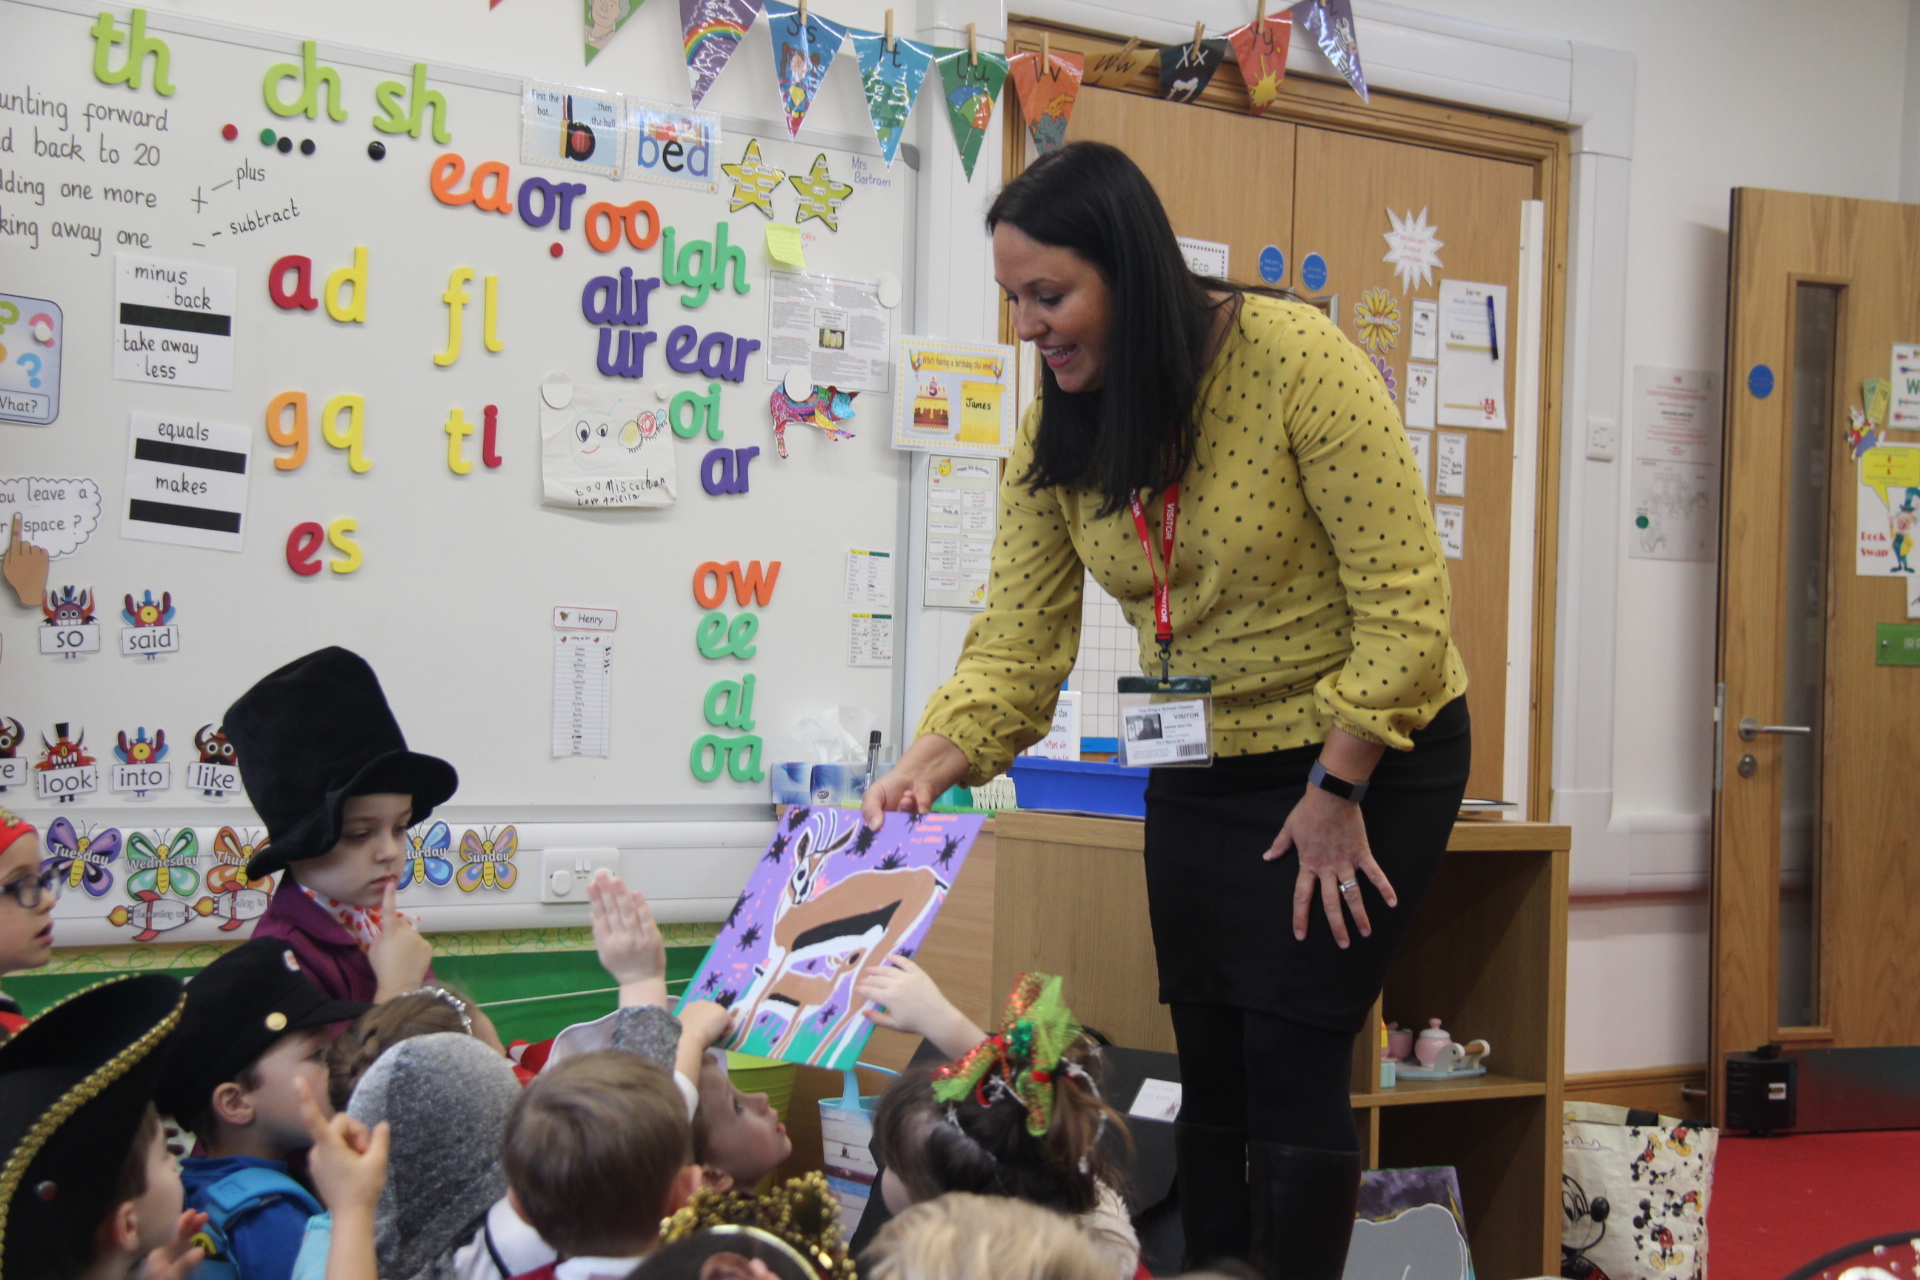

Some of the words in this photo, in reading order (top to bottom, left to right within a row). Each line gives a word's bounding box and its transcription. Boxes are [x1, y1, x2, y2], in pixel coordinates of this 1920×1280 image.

[91, 9, 175, 96] th
[263, 40, 348, 122] ch
[373, 63, 452, 144] sh
[531, 89, 547, 101] First
[547, 91, 560, 103] the
[82, 103, 169, 132] forward
[603, 117, 616, 128] ball
[34, 126, 85, 162] back
[99, 132, 120, 164] to
[133, 143, 160, 166] 20
[637, 112, 710, 178] bed
[236, 158, 266, 190] plus
[852, 156, 868, 171] Mrs
[61, 183, 93, 199] one
[104, 187, 157, 208] more
[430, 153, 513, 214] ea
[230, 197, 301, 235] subtract
[518, 177, 587, 230] or
[52, 221, 102, 257] away
[117, 230, 152, 249] one
[585, 200, 660, 252] oo
[135, 264, 189, 286] minus
[662, 221, 750, 308] igh
[174, 286, 212, 310] back
[582, 266, 660, 325] air
[1365, 315, 1394, 327] Monday
[123, 328, 155, 352] take
[161, 339, 199, 364] away
[597, 327, 657, 379] ur
[666, 325, 761, 383] ear
[145, 353, 177, 380] less
[669, 382, 724, 441] oi
[966, 397, 991, 411] James
[158, 421, 209, 442] equals
[156, 472, 208, 495] makes
[701, 446, 760, 495] ar
[28, 480, 66, 501] leave
[79, 488, 89, 499] a
[24, 519, 66, 541] space
[1164, 502, 1176, 541] VISITOR
[1861, 531, 1886, 542] Book
[1861, 547, 1889, 558] Swap
[693, 560, 782, 609] ow
[578, 613, 604, 626] Henry
[57, 630, 84, 648] so
[129, 628, 172, 650] said
[696, 611, 759, 659] ee
[704, 673, 756, 731] ai
[1173, 712, 1200, 720] VISITOR
[690, 734, 765, 782] oa
[42, 770, 93, 793] look
[120, 767, 163, 787] into
[196, 766, 235, 789] like
[54, 843, 110, 869] Tuesday
[126, 853, 200, 871] Wednesday
[467, 849, 510, 863] Sunday
